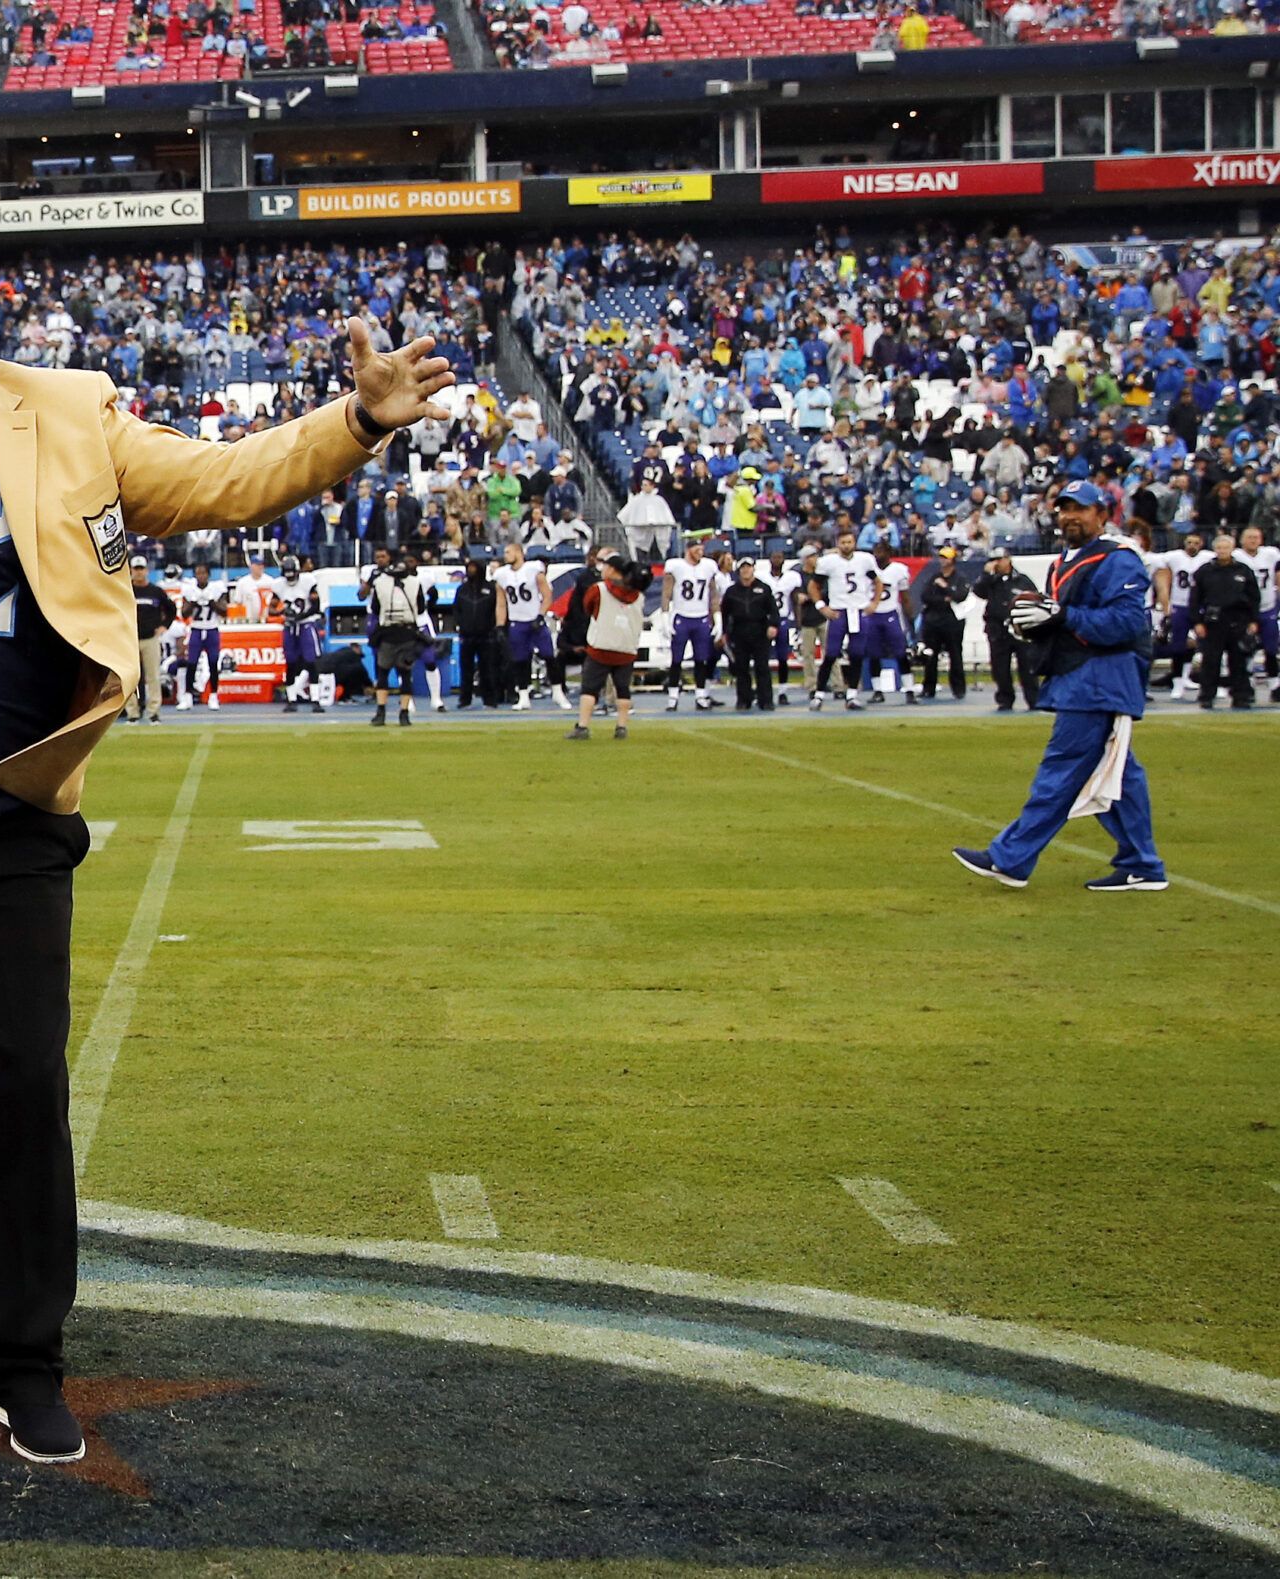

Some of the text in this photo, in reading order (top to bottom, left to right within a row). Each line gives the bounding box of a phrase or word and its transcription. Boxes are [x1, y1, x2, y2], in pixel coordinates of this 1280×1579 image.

[1193, 154, 1280, 187] xfinity
[843, 171, 959, 194] NISSAN
[40, 204, 93, 225] Paper
[97, 202, 111, 220] &
[115, 200, 165, 219] Twine
[171, 198, 199, 216] Co.
[260, 195, 294, 217] LP
[307, 188, 512, 212] BUILDING PRODUCTS
[506, 582, 532, 605] 86
[681, 579, 707, 601] 87
[845, 573, 858, 594] 5
